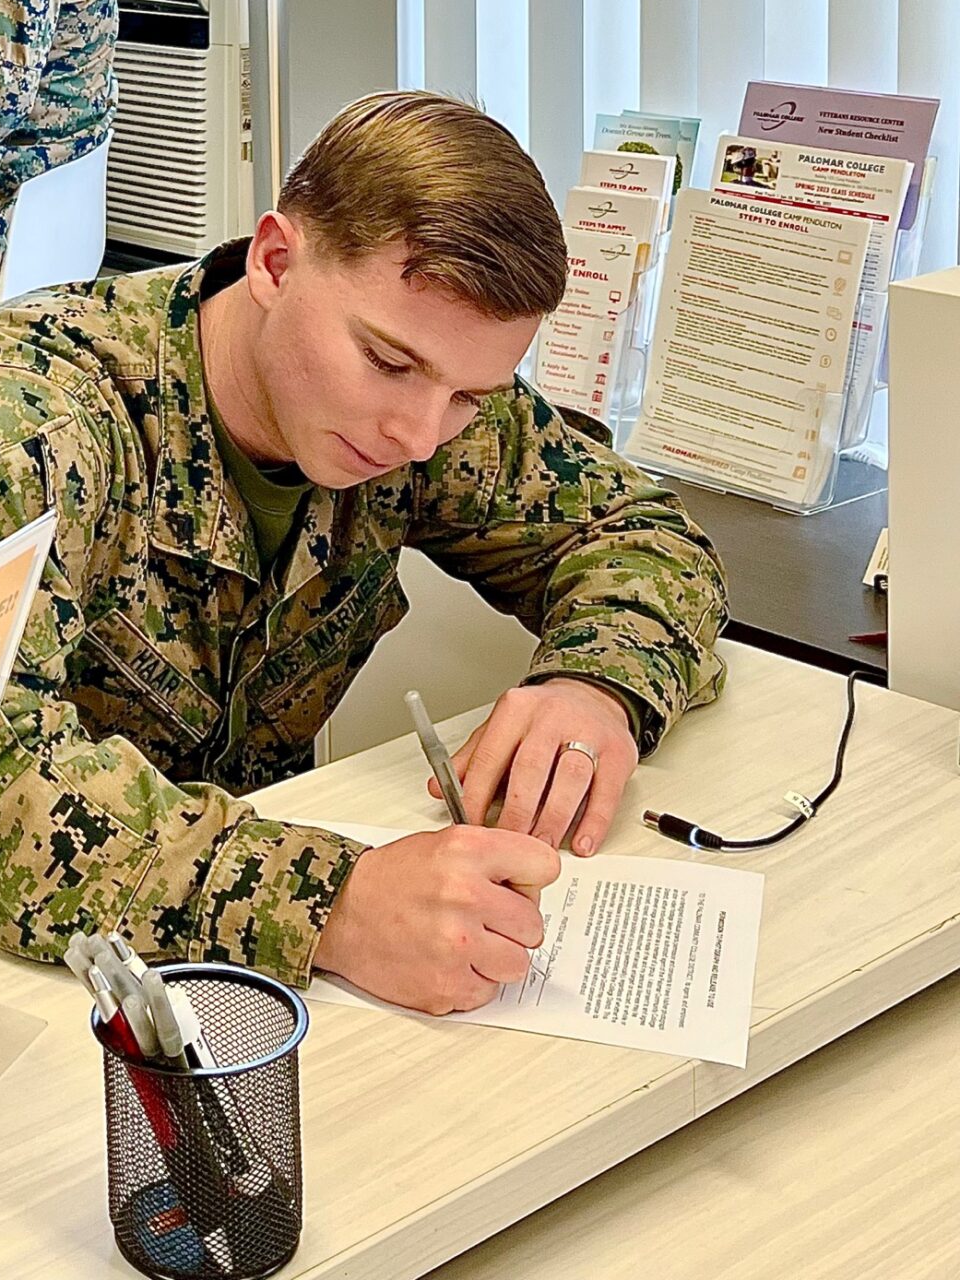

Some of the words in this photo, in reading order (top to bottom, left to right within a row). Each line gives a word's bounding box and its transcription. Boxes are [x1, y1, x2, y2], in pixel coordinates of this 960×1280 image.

[819, 111, 849, 121] VETERANS
[850, 114, 880, 124] RESOURCE
[881, 117, 905, 126] CENTER
[818, 125, 834, 135] New
[835, 128, 863, 139] Student
[864, 131, 898, 143] Checklist
[797, 154, 844, 168] PALOMAR
[846, 160, 886, 174] COLLEGE
[830, 168, 866, 178] PENDLETON
[628, 185, 648, 193] APPLY
[795, 182, 815, 191] SPRING
[831, 187, 847, 196] CLASS
[848, 190, 876, 200] SCHEDULE
[710, 197, 748, 212] PALOMAR
[750, 205, 782, 218] COLLEGE
[783, 212, 802, 222] CAMP
[803, 216, 842, 230] PENDLETON
[579, 220, 596, 228] STEPS
[738, 212, 762, 226] STEPS
[765, 218, 777, 227] TO
[778, 221, 809, 233] ENROLL
[565, 256, 586, 267] TEPS
[573, 269, 608, 281] ENROLL
[302, 573, 381, 658] MARINES
